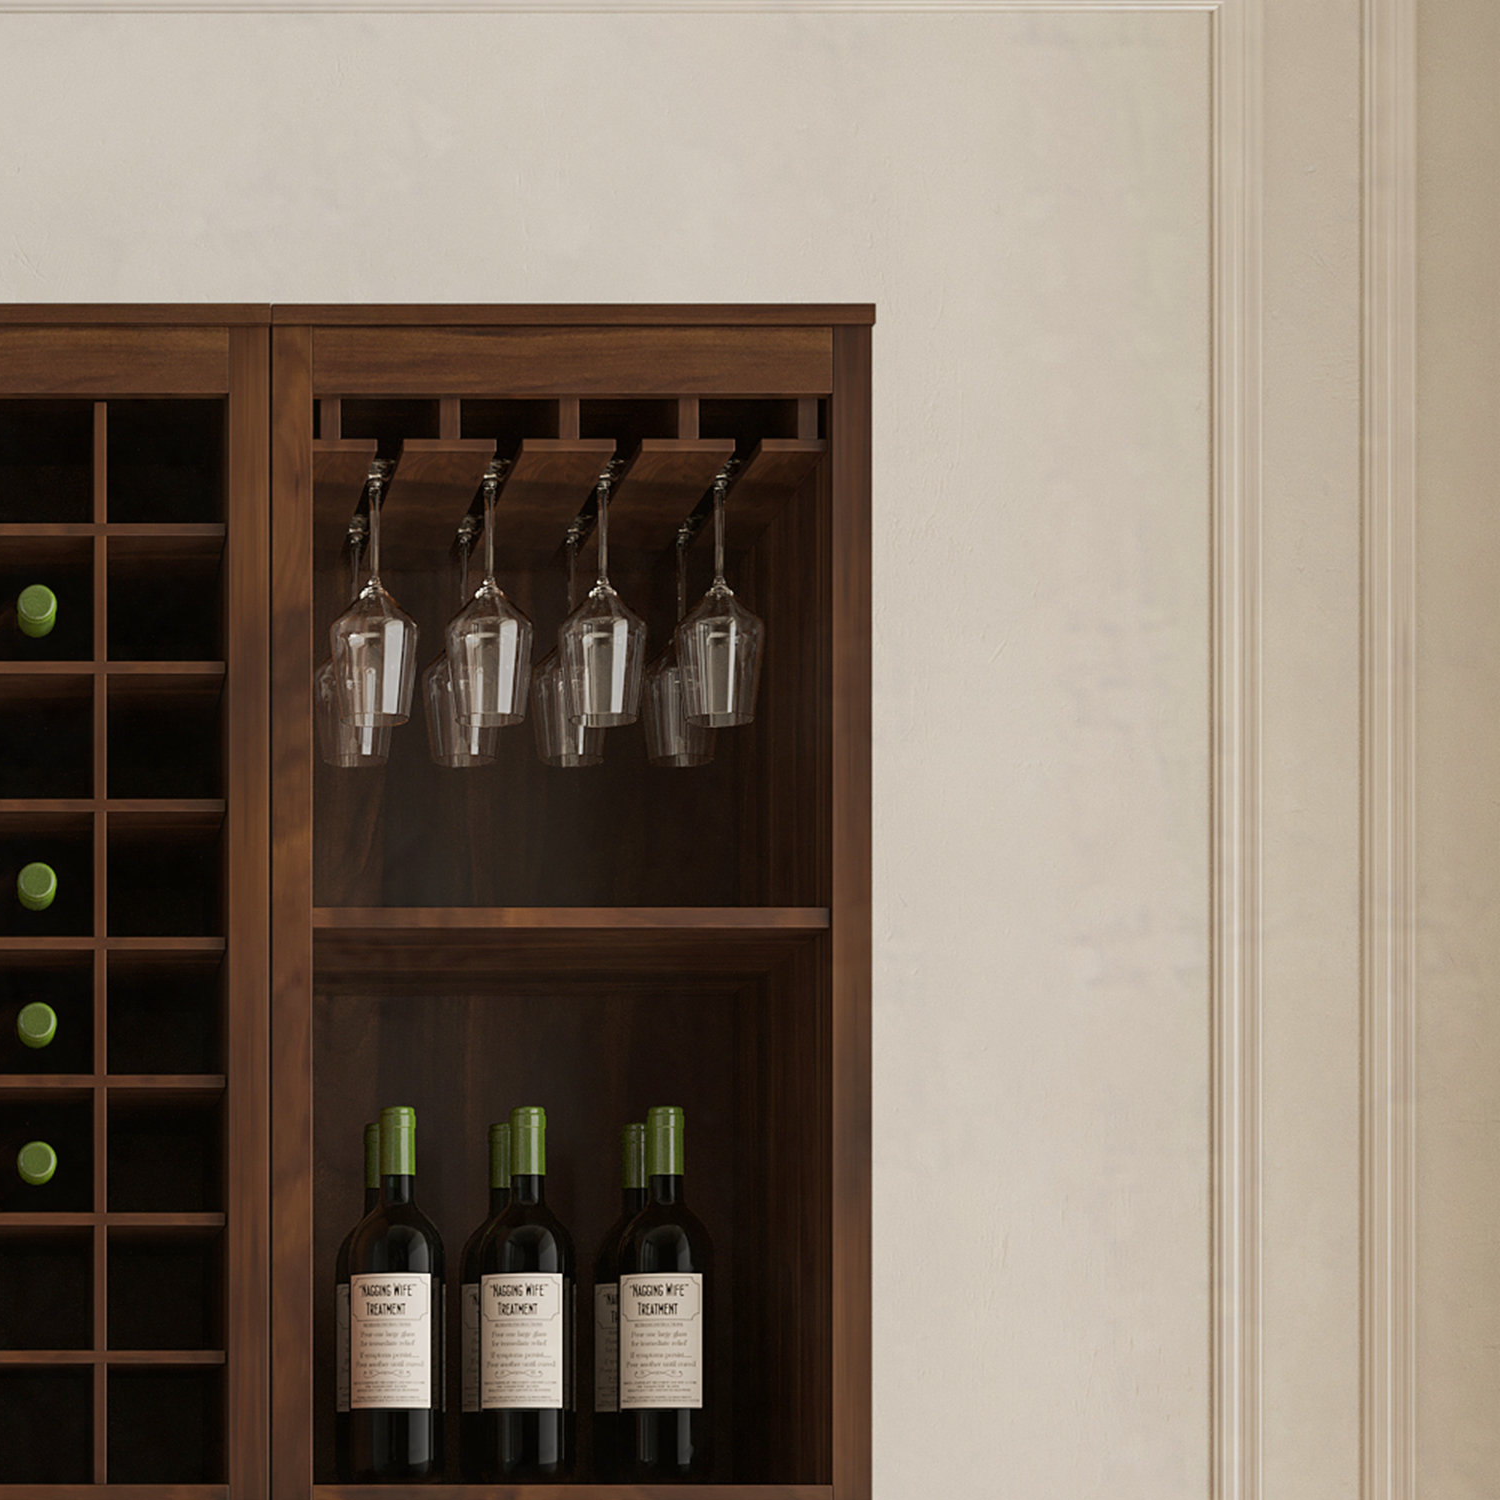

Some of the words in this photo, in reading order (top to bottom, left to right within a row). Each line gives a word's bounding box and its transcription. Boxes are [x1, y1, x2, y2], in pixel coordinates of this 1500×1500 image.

[366, 1302, 406, 1316] TREATMENT
[498, 1302, 538, 1316] TREATMENT
[638, 1302, 678, 1316] TREATMENT
